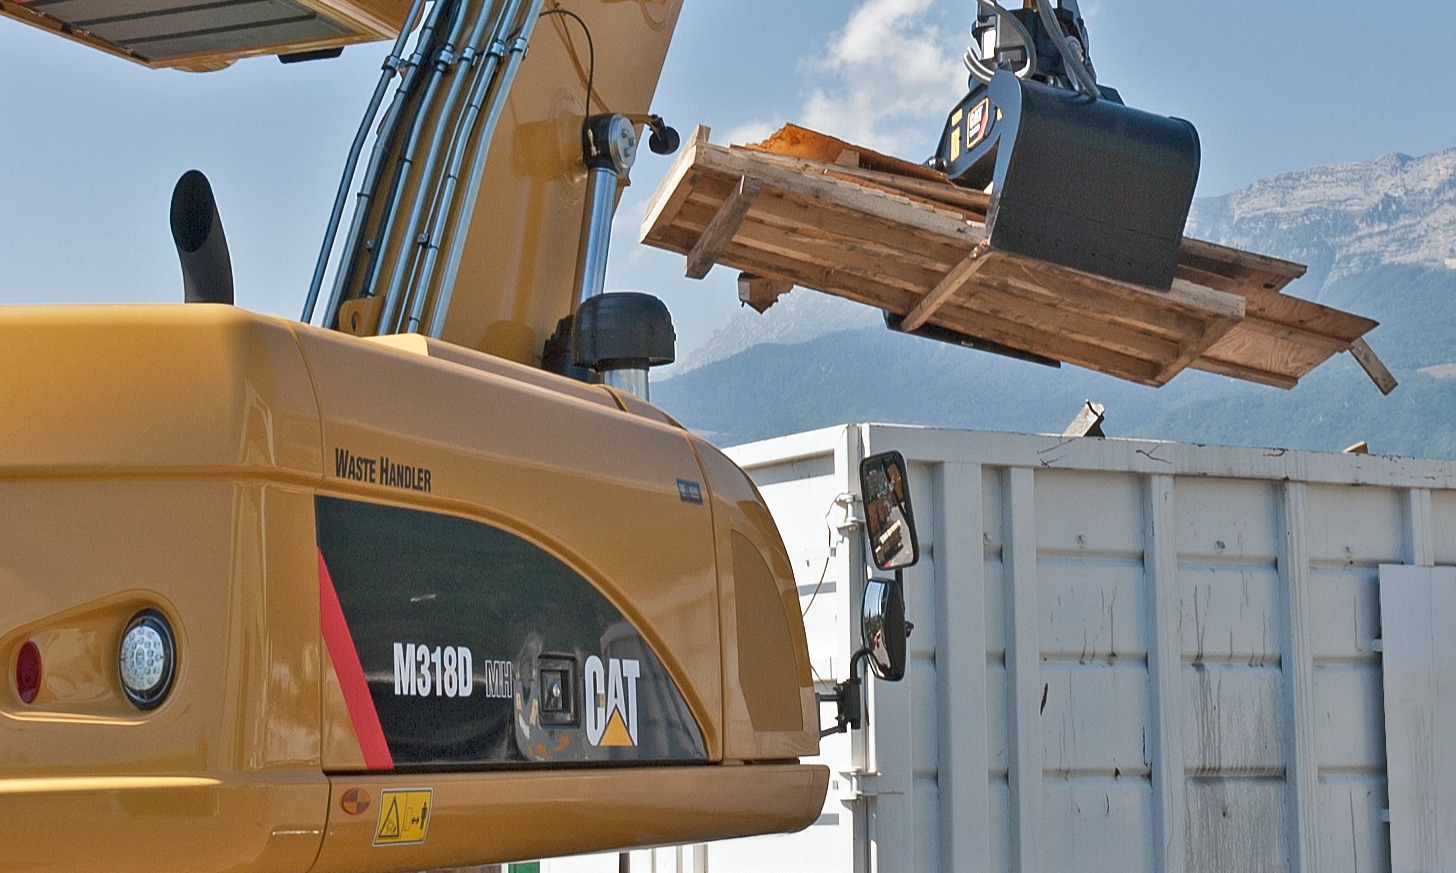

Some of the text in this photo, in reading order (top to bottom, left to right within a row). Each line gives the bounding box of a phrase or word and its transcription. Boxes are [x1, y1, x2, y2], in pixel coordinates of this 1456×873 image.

[335, 448, 431, 492] WASTE HANDLER
[393, 643, 513, 698] M318D MH
[585, 655, 641, 746] CAT
